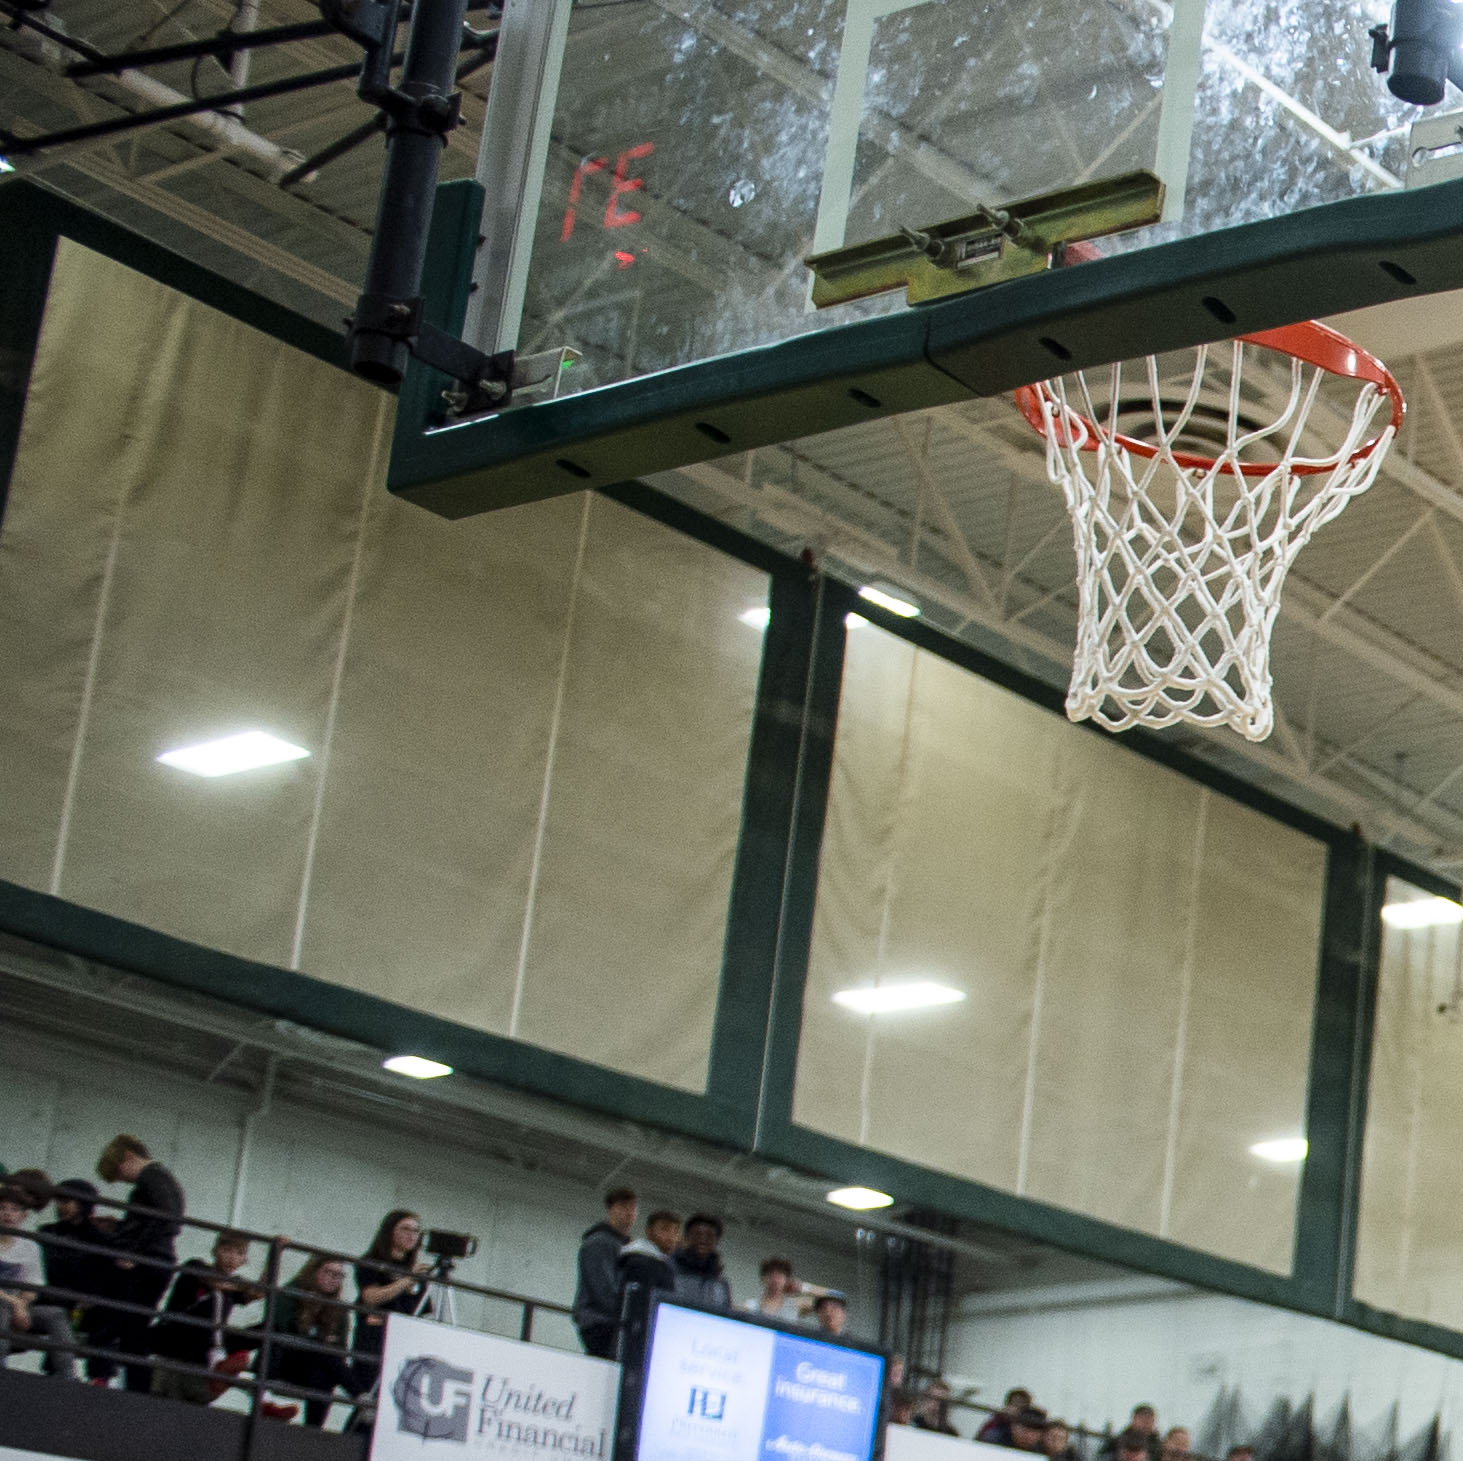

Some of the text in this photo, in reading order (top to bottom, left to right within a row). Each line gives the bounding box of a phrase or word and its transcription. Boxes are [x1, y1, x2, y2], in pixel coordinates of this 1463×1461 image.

[421, 1373, 471, 1416] UF
[481, 1375, 576, 1420] United
[796, 1362, 847, 1389] Great
[478, 1405, 607, 1459] Financial
